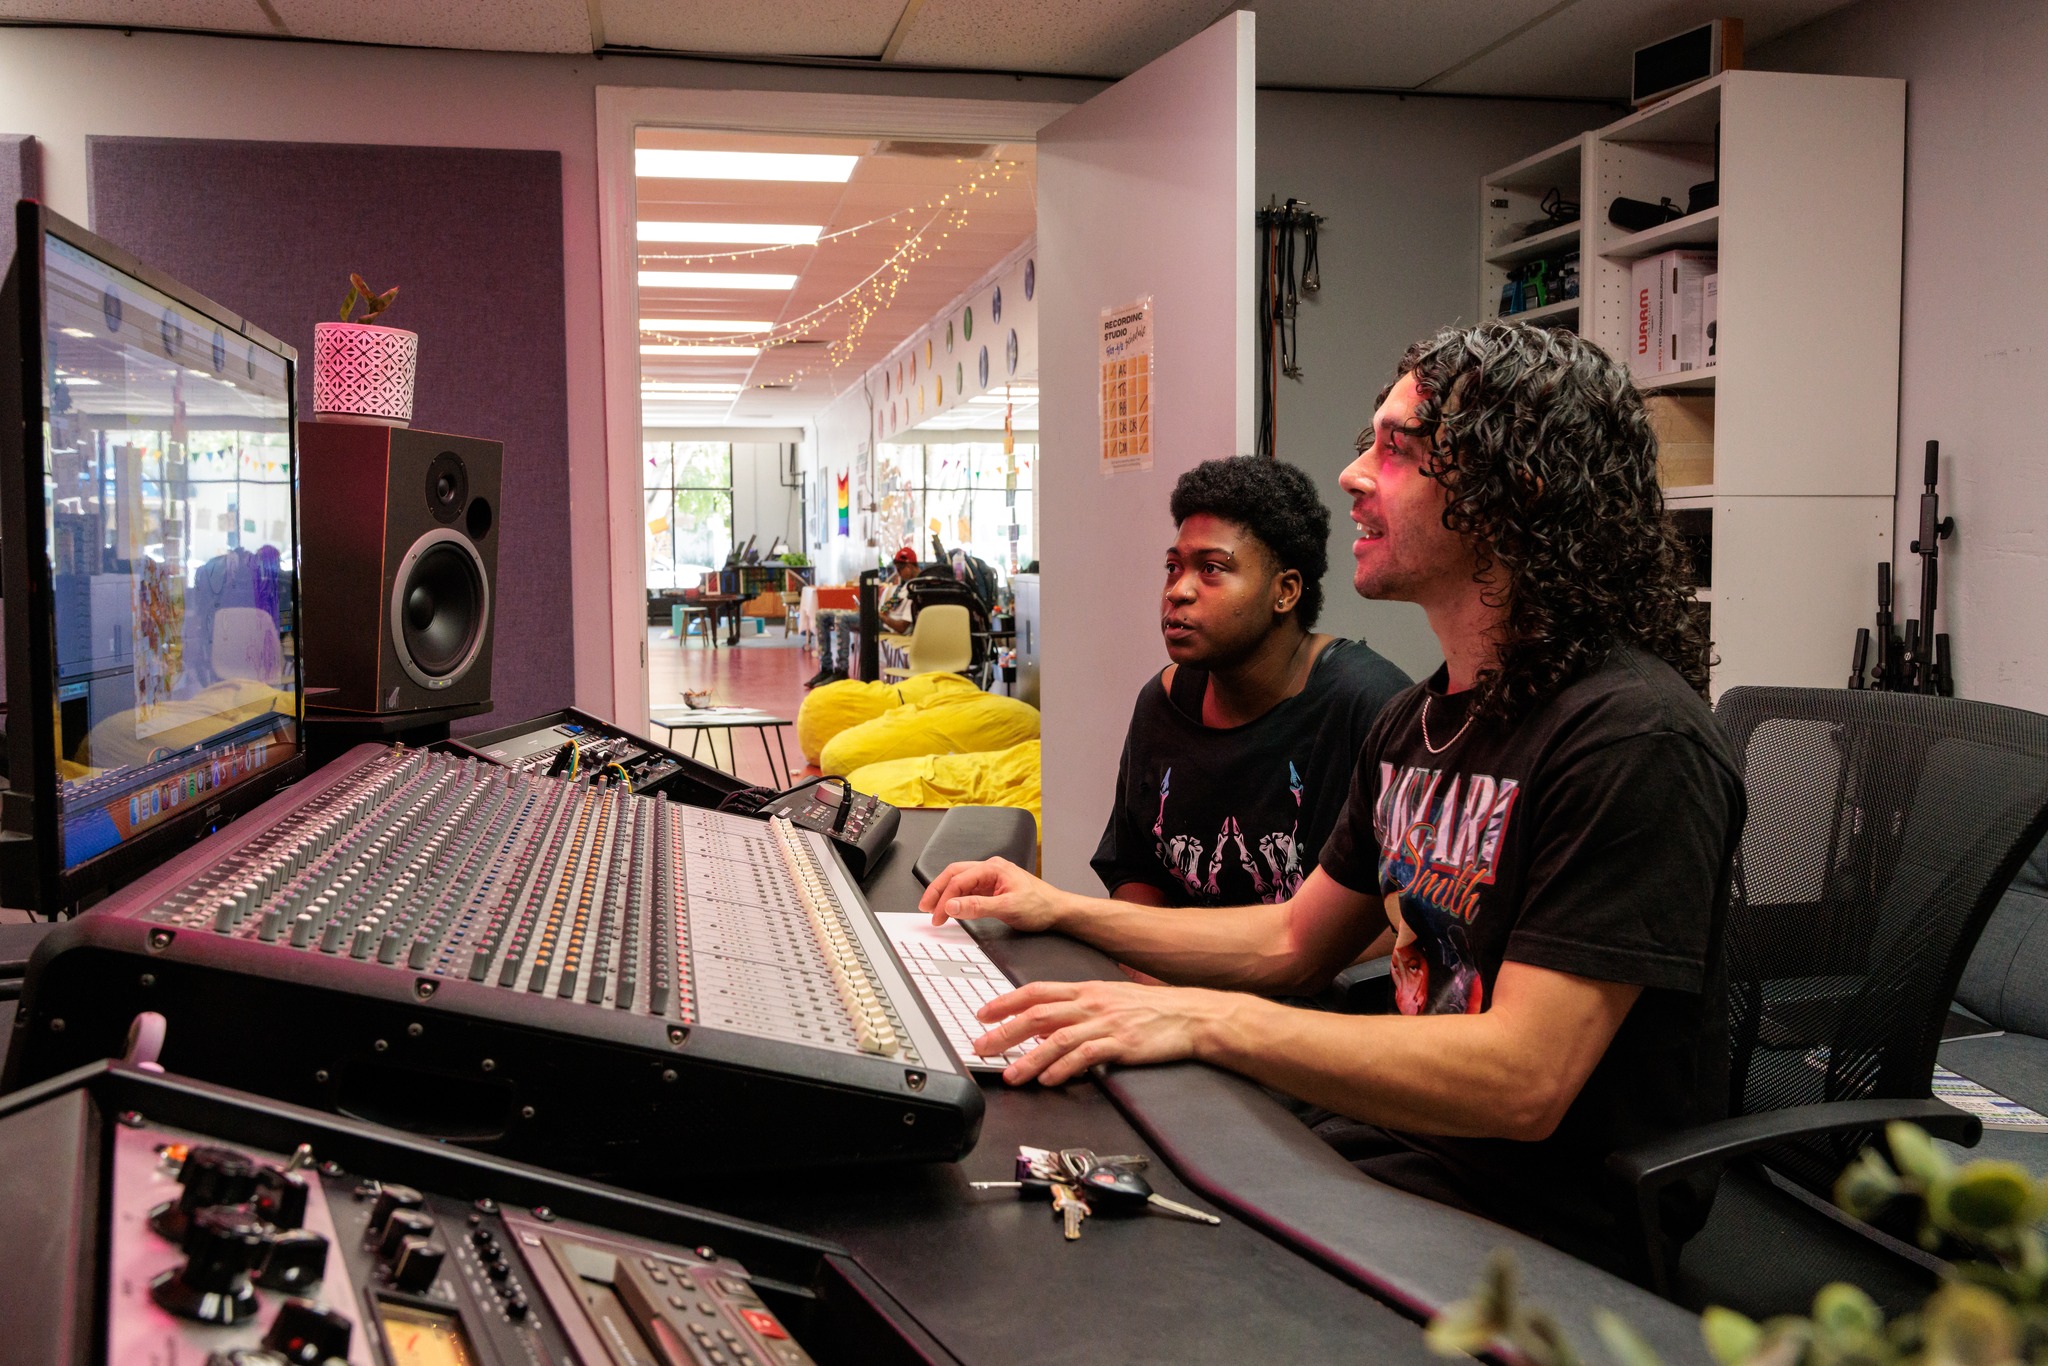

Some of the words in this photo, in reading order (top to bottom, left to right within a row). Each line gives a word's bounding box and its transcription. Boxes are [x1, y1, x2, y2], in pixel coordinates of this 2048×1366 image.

[1104, 312, 1143, 330] RECORDING
[1104, 328, 1128, 341] STUDIO
[1638, 289, 1649, 355] WARM
[1387, 821, 1487, 924] Smith
